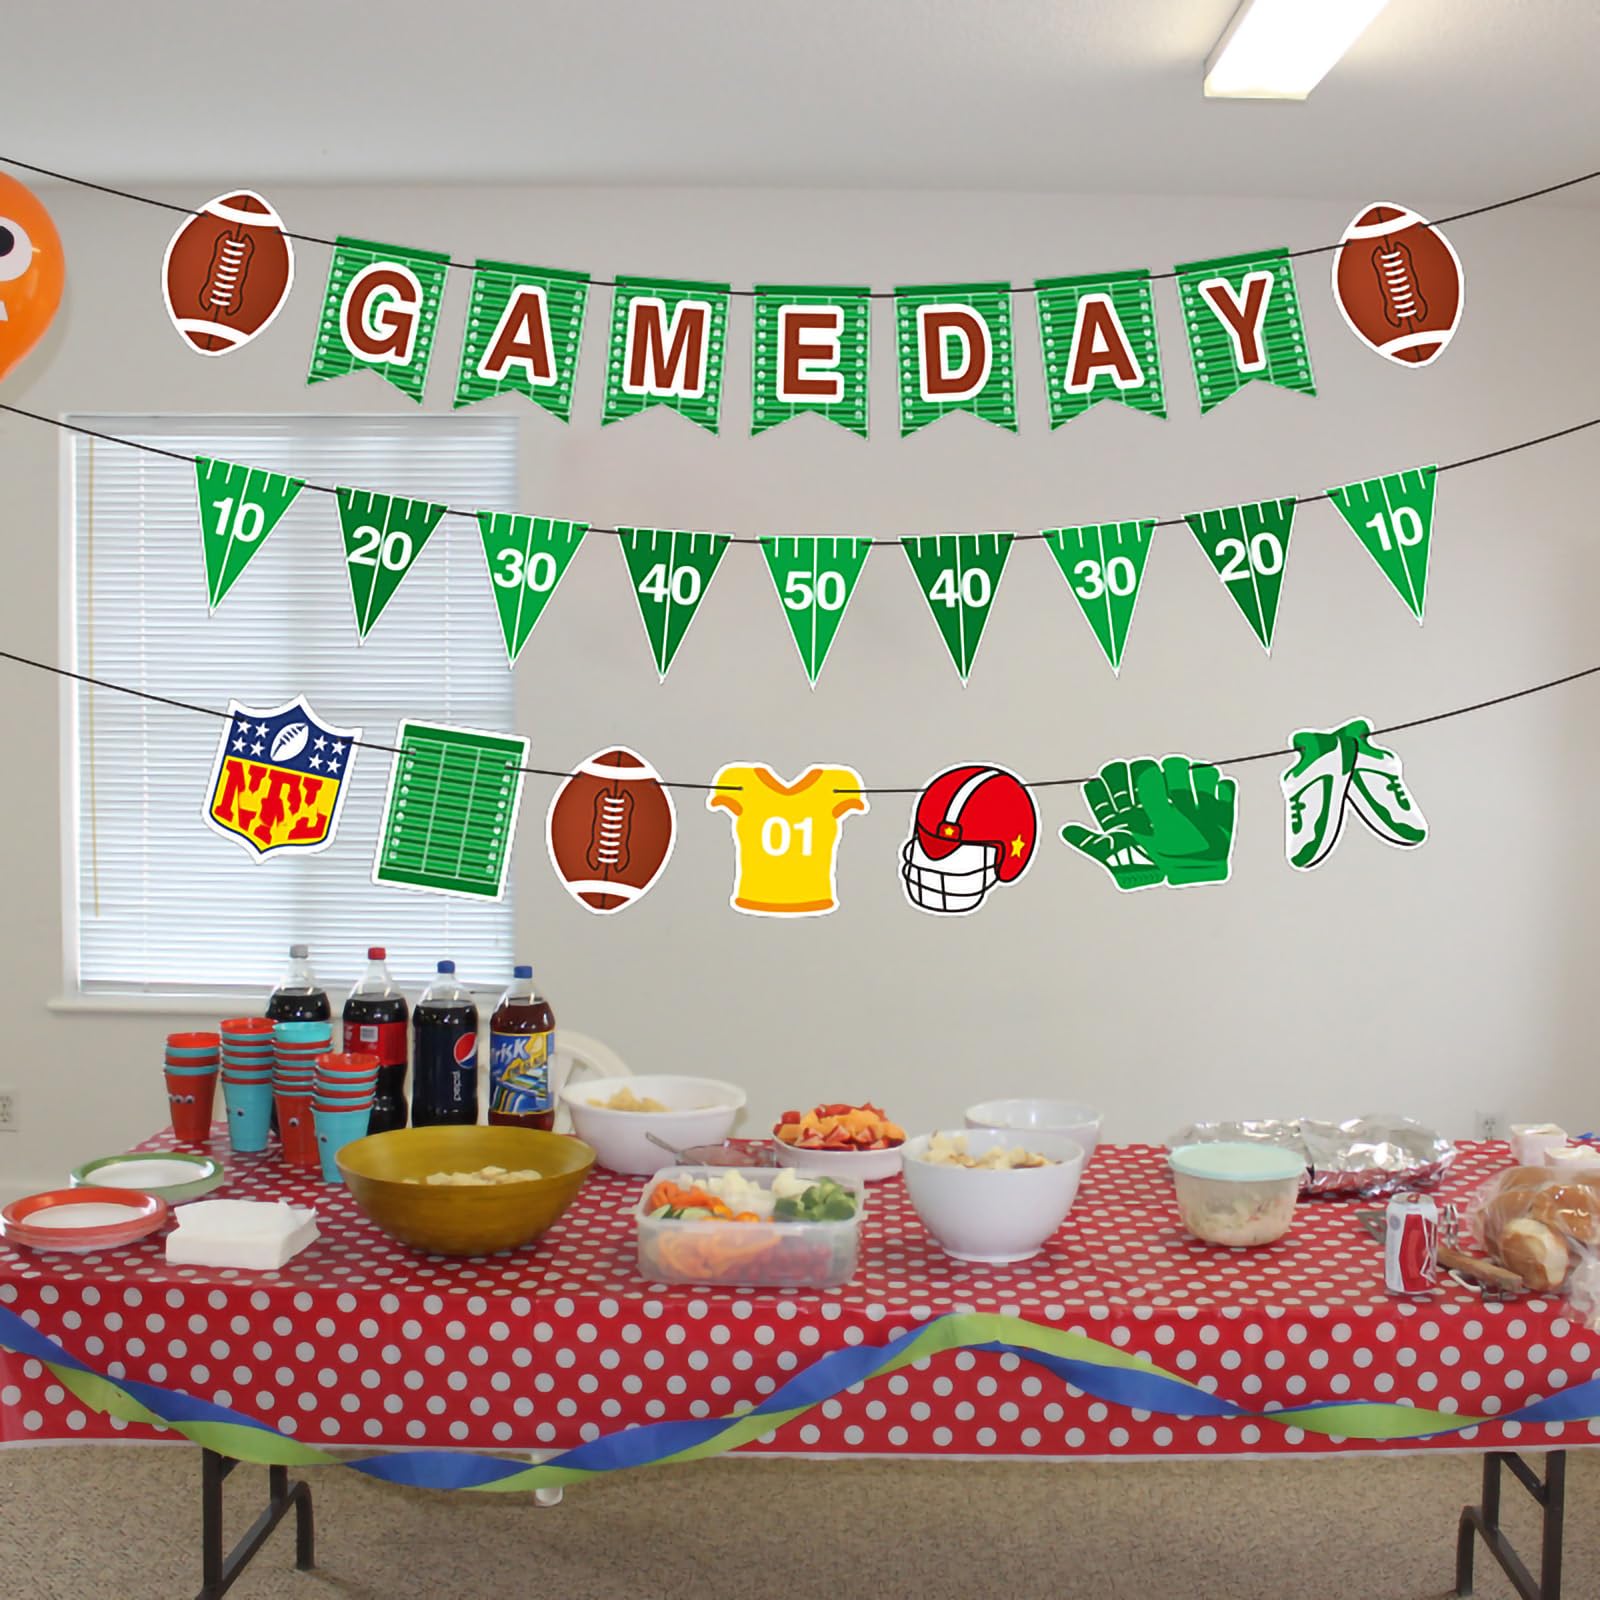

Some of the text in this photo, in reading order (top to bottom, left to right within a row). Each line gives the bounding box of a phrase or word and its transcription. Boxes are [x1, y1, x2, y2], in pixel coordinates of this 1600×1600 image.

[212, 497, 1424, 611] 10 20 30 40 50 40 30 20 10
[761, 816, 814, 857] 01
